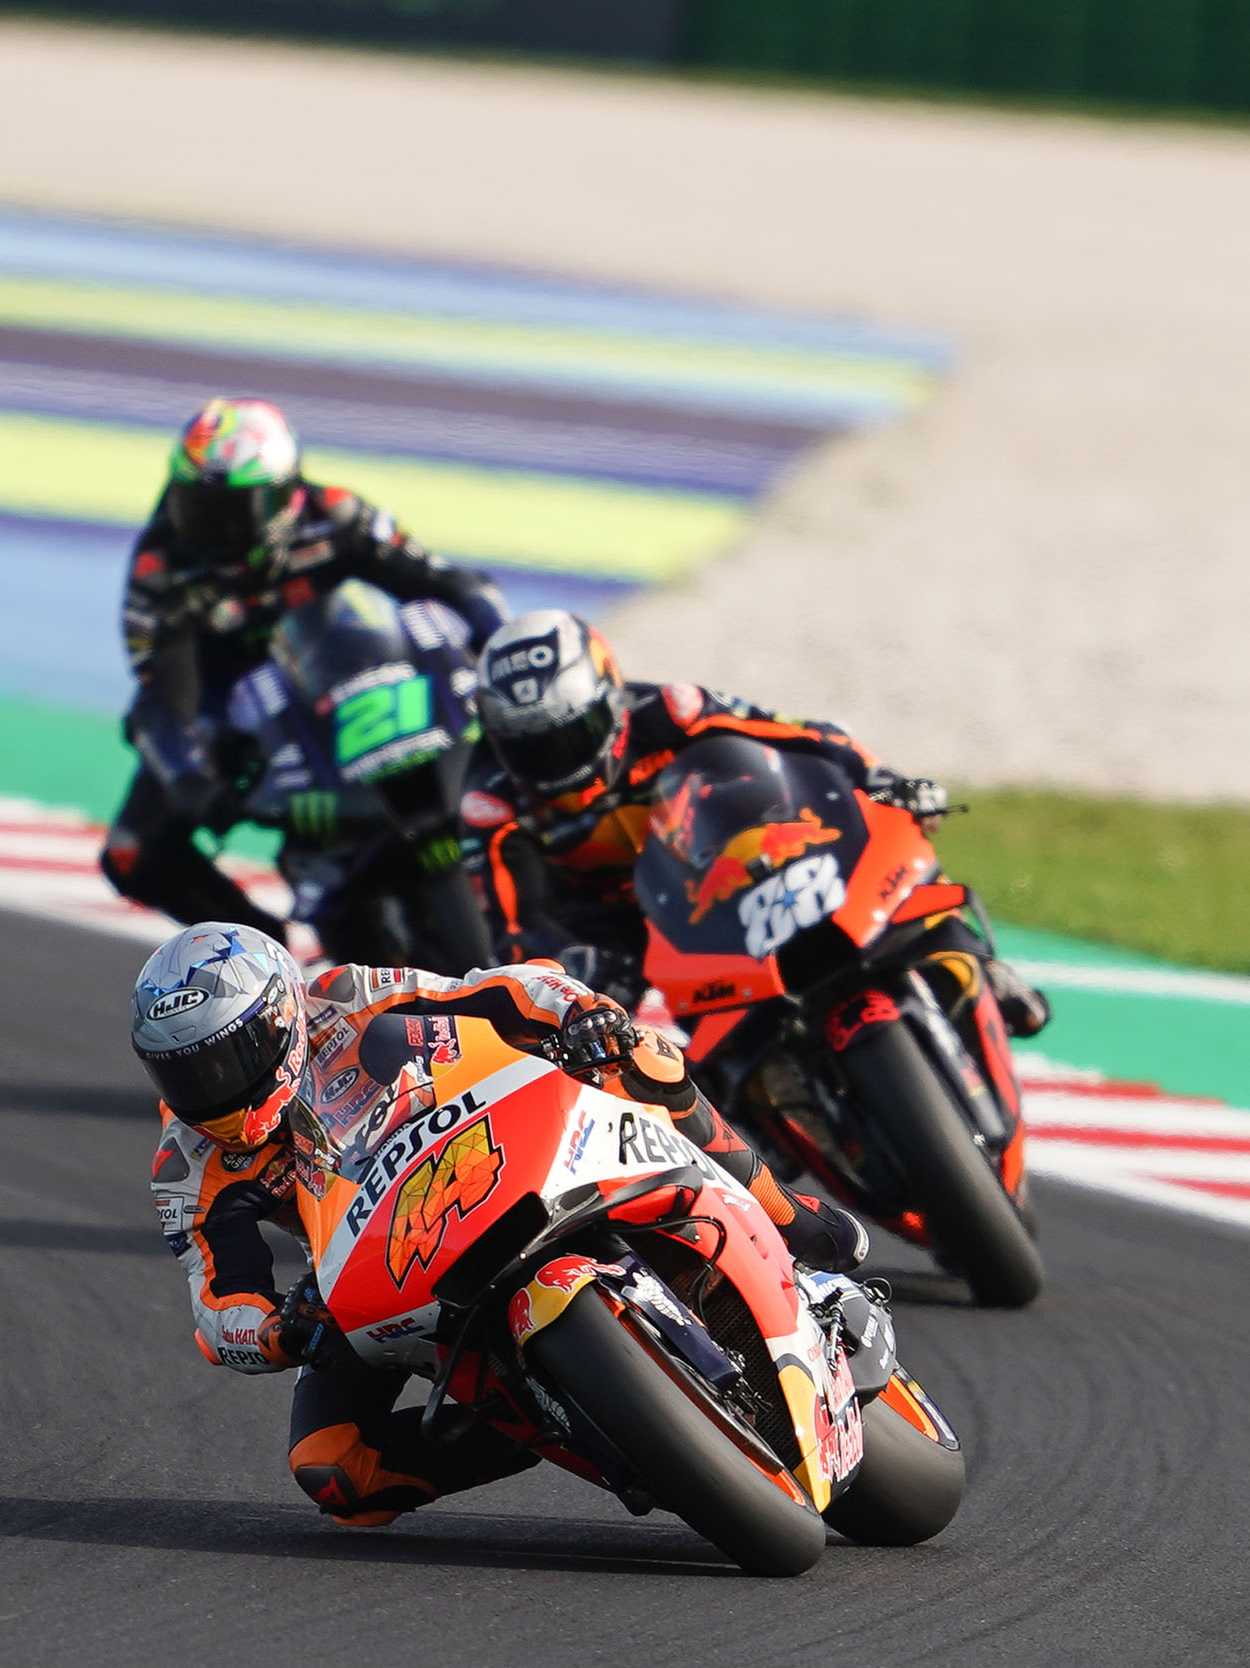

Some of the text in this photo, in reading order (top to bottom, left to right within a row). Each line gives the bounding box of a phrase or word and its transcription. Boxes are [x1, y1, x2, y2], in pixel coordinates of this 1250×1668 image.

[335, 675, 430, 764] 21
[153, 990, 199, 1018] HJC
[176, 1043, 200, 1057] YOU
[203, 1018, 244, 1047] WINGS
[316, 1026, 350, 1065] REPSOL
[563, 1110, 595, 1176] HRC
[346, 1091, 486, 1238] REPSOL
[158, 1208, 178, 1219] SOL
[386, 1113, 507, 1293] 44
[366, 1316, 425, 1344] HRC
[217, 1346, 270, 1365] REPSO
